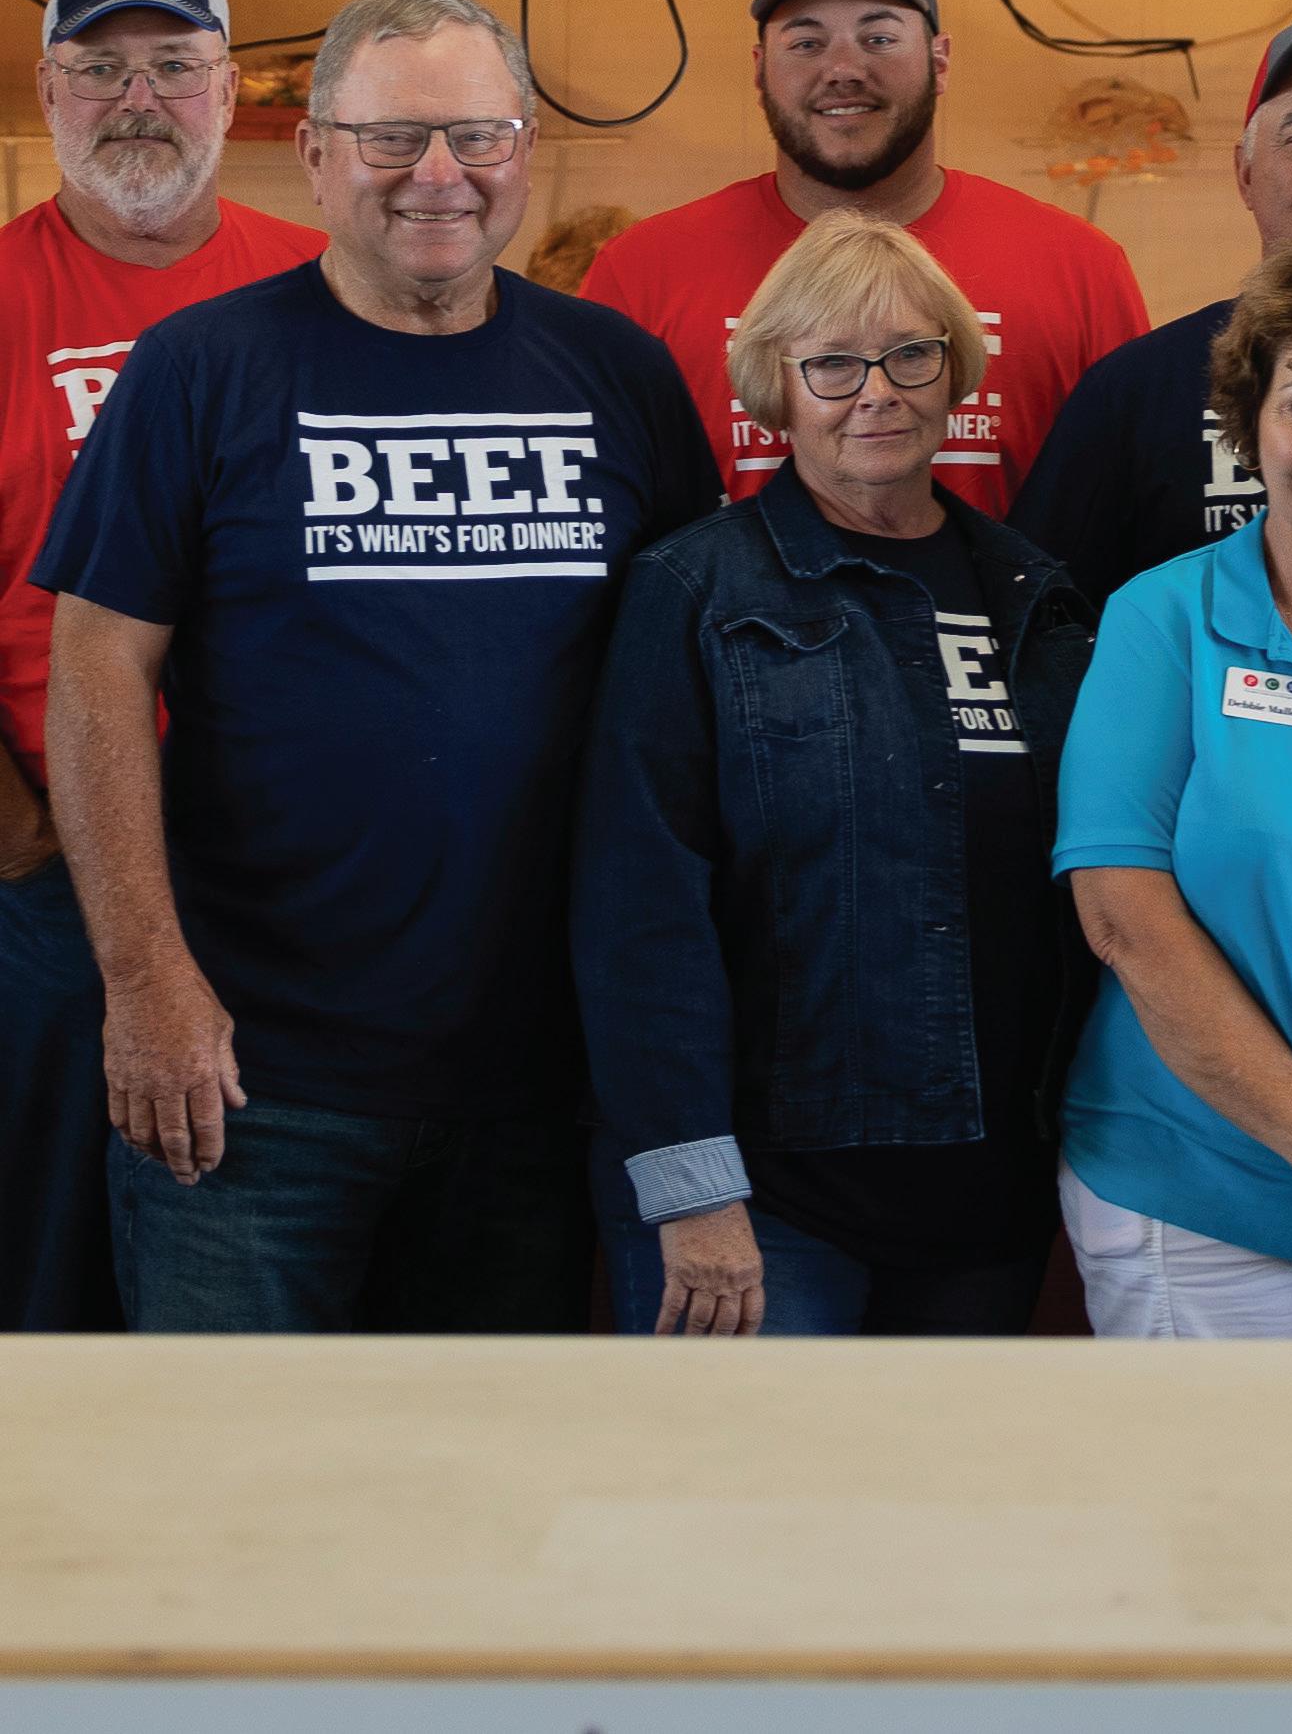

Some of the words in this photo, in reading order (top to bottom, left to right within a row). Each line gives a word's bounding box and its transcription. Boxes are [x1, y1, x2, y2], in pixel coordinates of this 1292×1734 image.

[299, 437, 604, 517] BEEF.
[304, 525, 354, 554] IT'S
[356, 524, 452, 553] WHAT'S
[457, 524, 506, 552] FOR
